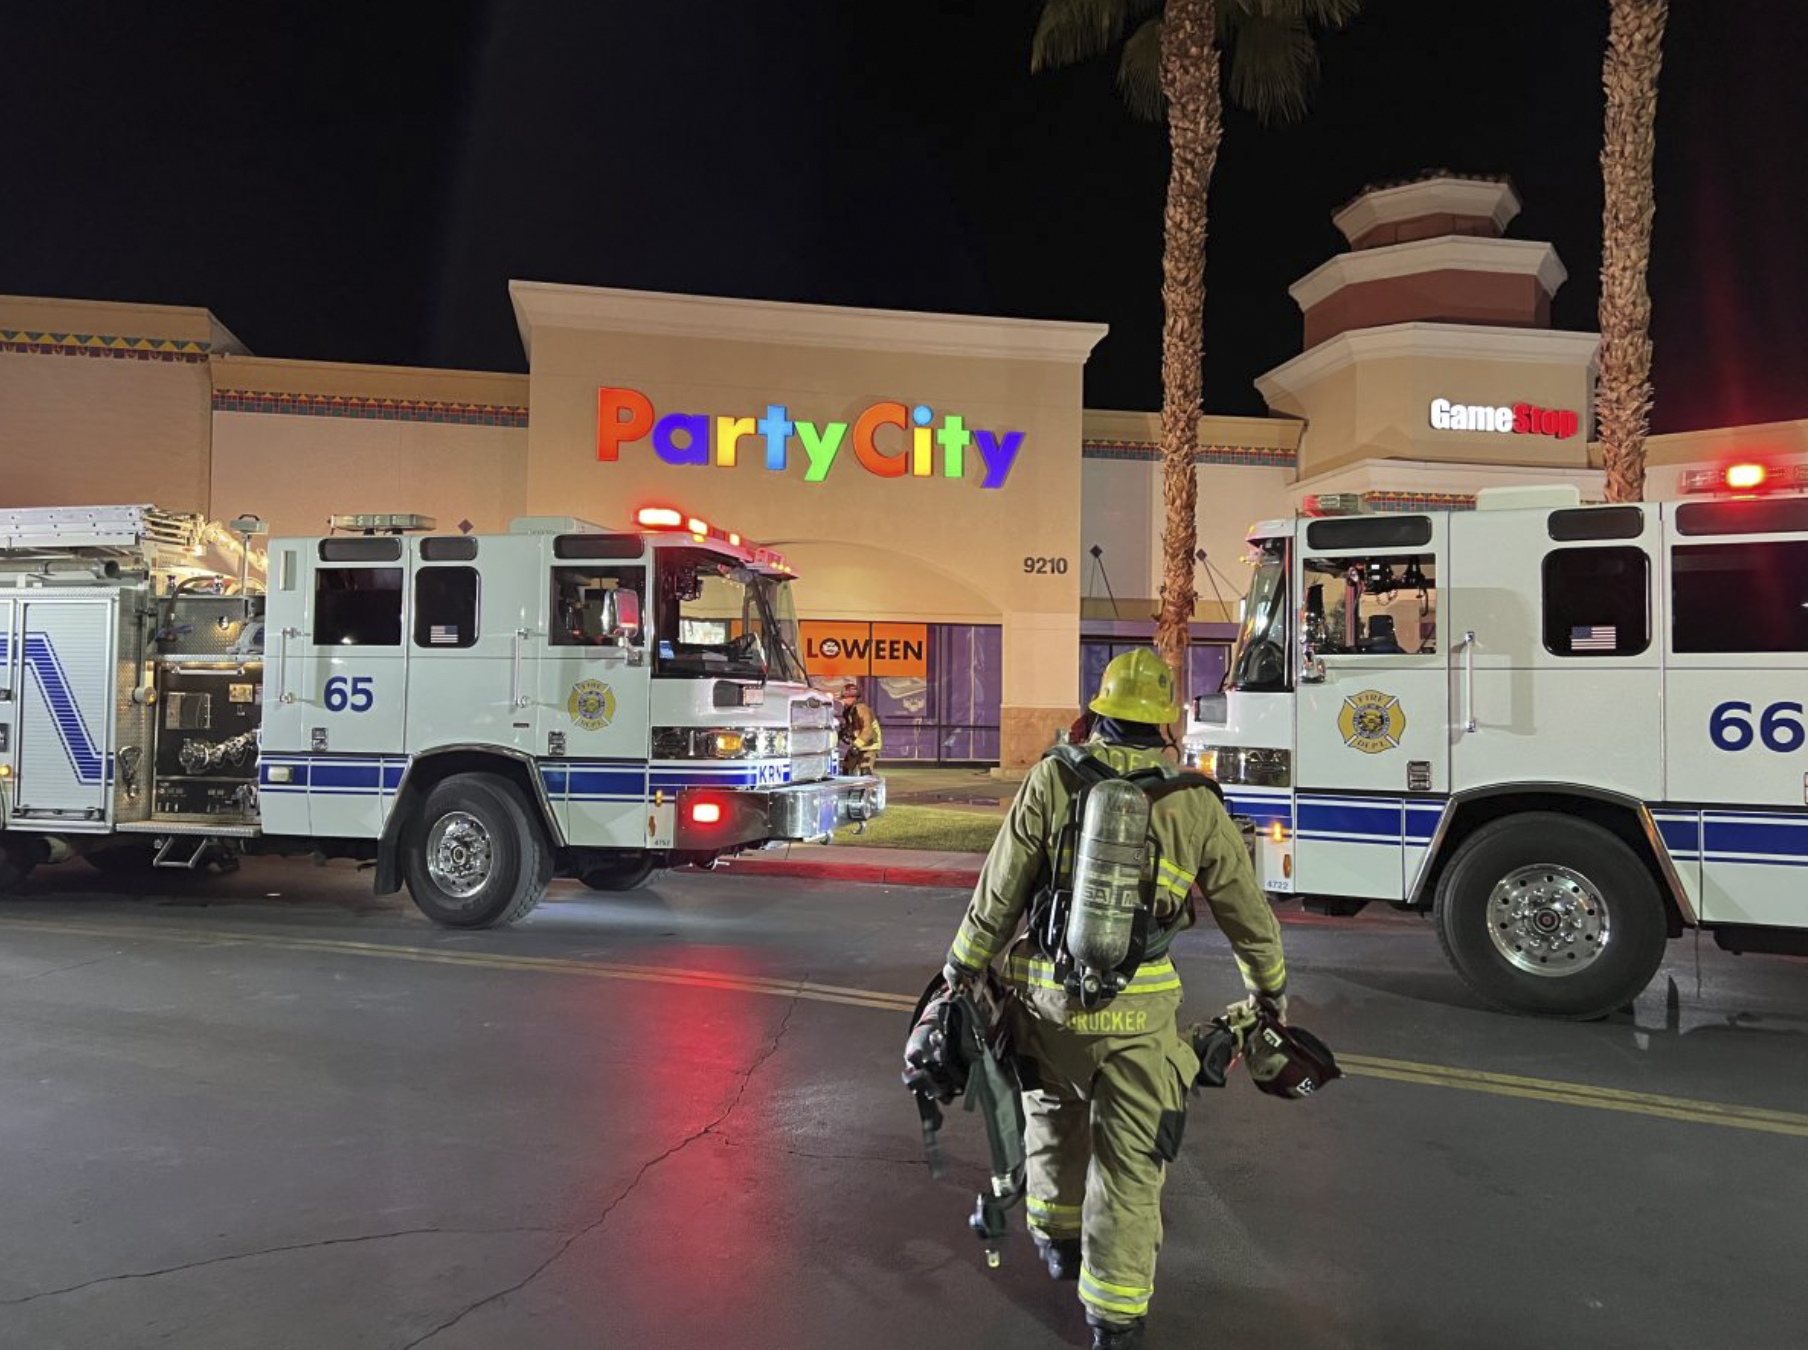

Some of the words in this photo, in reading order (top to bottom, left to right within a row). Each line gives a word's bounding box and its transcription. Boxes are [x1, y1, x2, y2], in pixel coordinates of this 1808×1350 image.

[1430, 398, 1578, 439] GameStop
[1023, 557, 1068, 575] 9210
[323, 676, 374, 712] 65
[1709, 701, 1805, 753] 66
[758, 764, 783, 784] KRN
[1266, 879, 1289, 890] 4722
